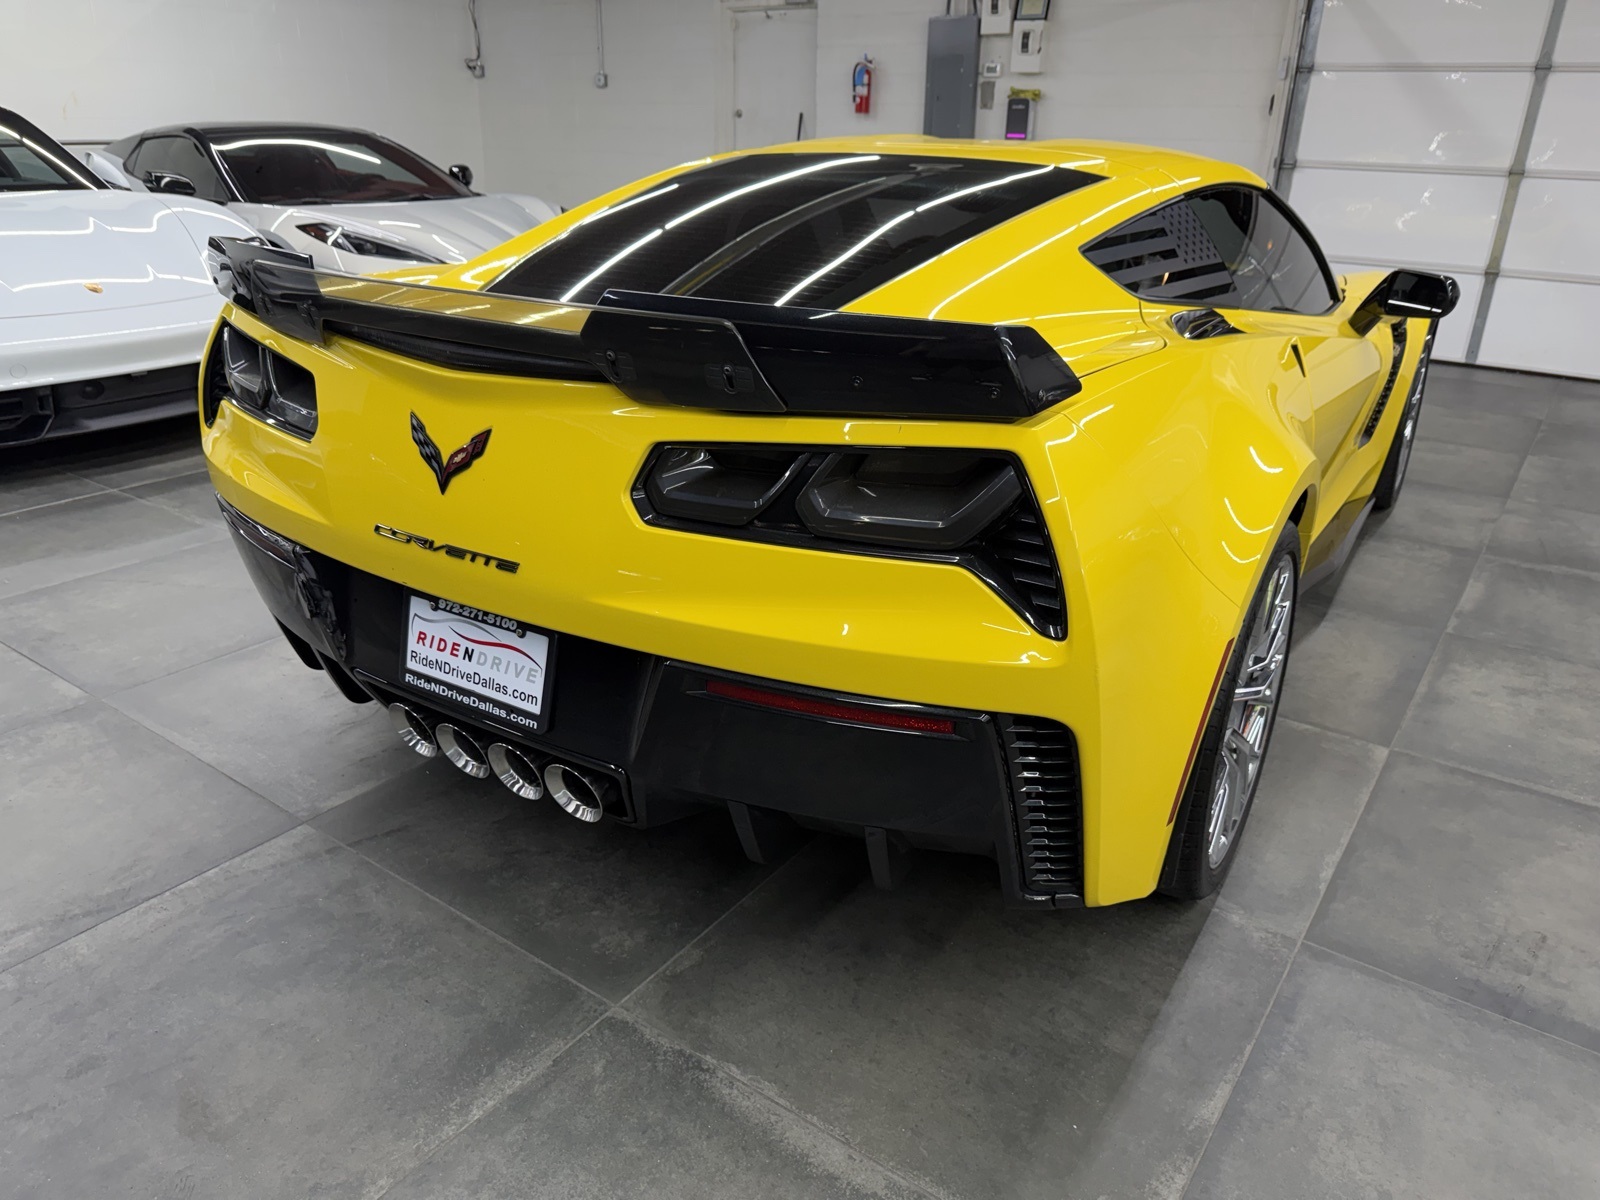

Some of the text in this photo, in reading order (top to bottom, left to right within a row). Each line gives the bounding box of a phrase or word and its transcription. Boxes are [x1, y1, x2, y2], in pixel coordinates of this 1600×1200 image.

[374, 523, 520, 574] CORVETTE
[438, 599, 517, 630] 972-271-5100
[405, 673, 538, 729] RideNDriveDallas.com
[410, 650, 538, 706] RideNDriveDallas.com
